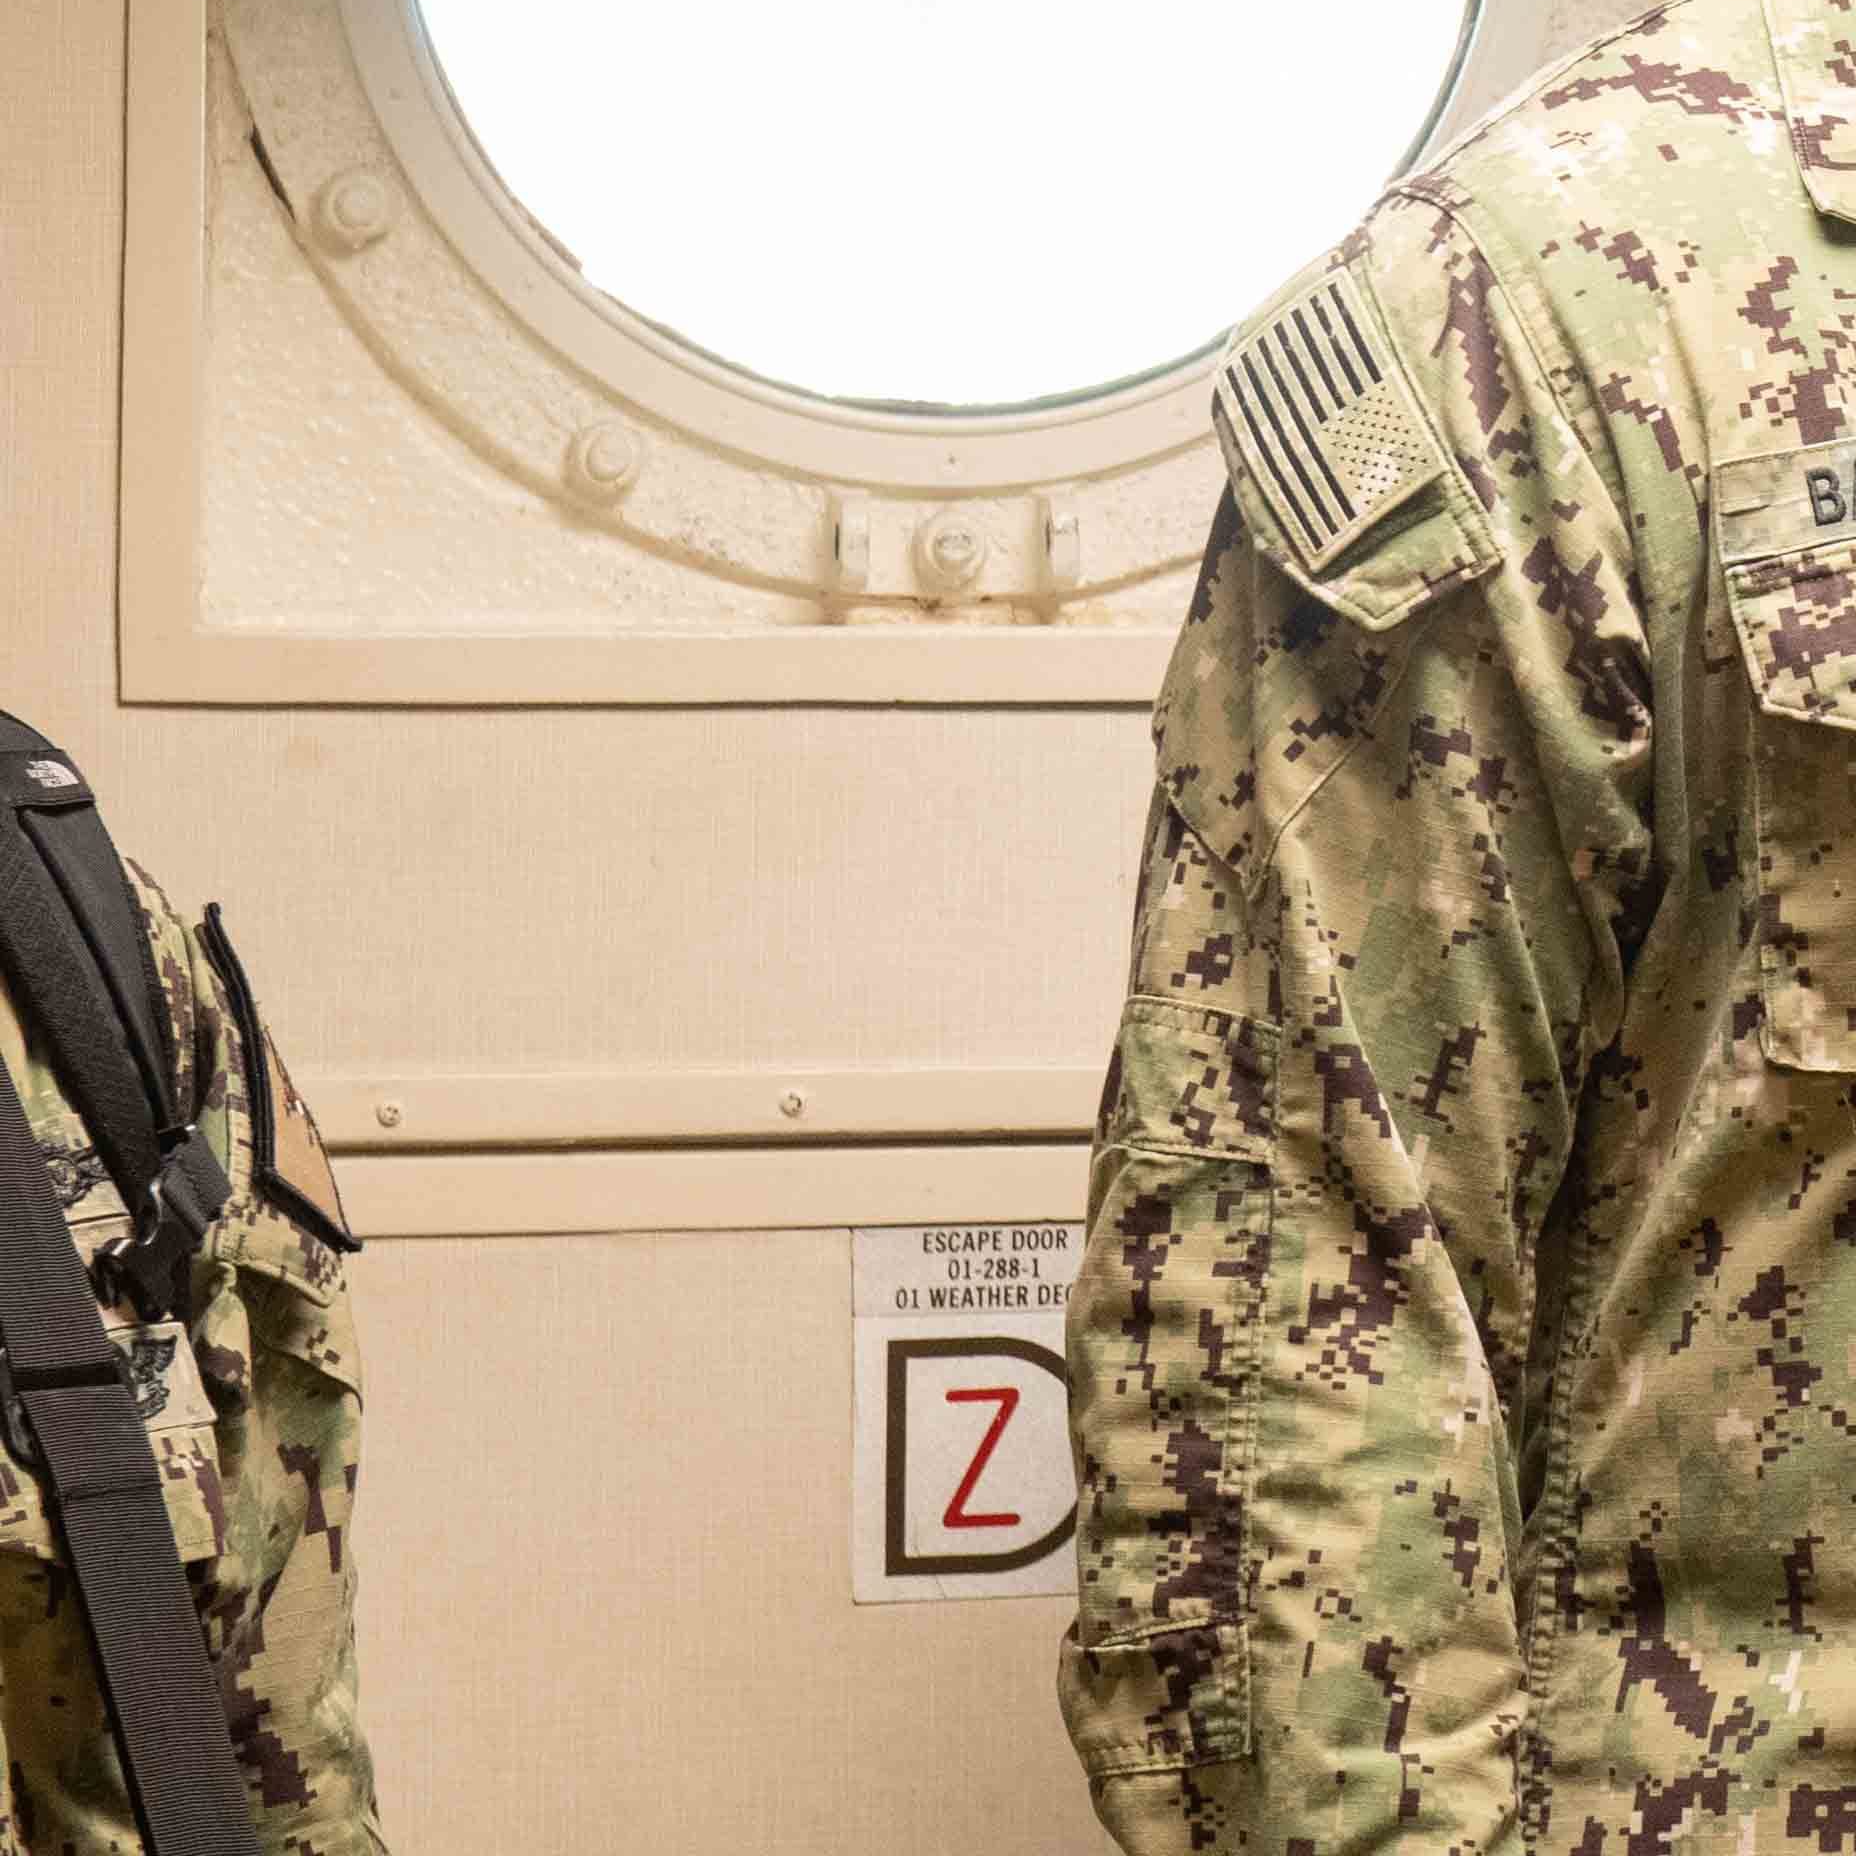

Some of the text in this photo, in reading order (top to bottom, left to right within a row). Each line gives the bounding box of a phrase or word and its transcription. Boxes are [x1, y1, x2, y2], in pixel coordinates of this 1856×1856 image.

[921, 1228, 1069, 1255] ESCAPE DOOR
[947, 1257, 1041, 1281] 01-288-1
[894, 1286, 922, 1310] 01
[928, 1283, 1029, 1309] WEATHER
[943, 1387, 1022, 1528] Z
